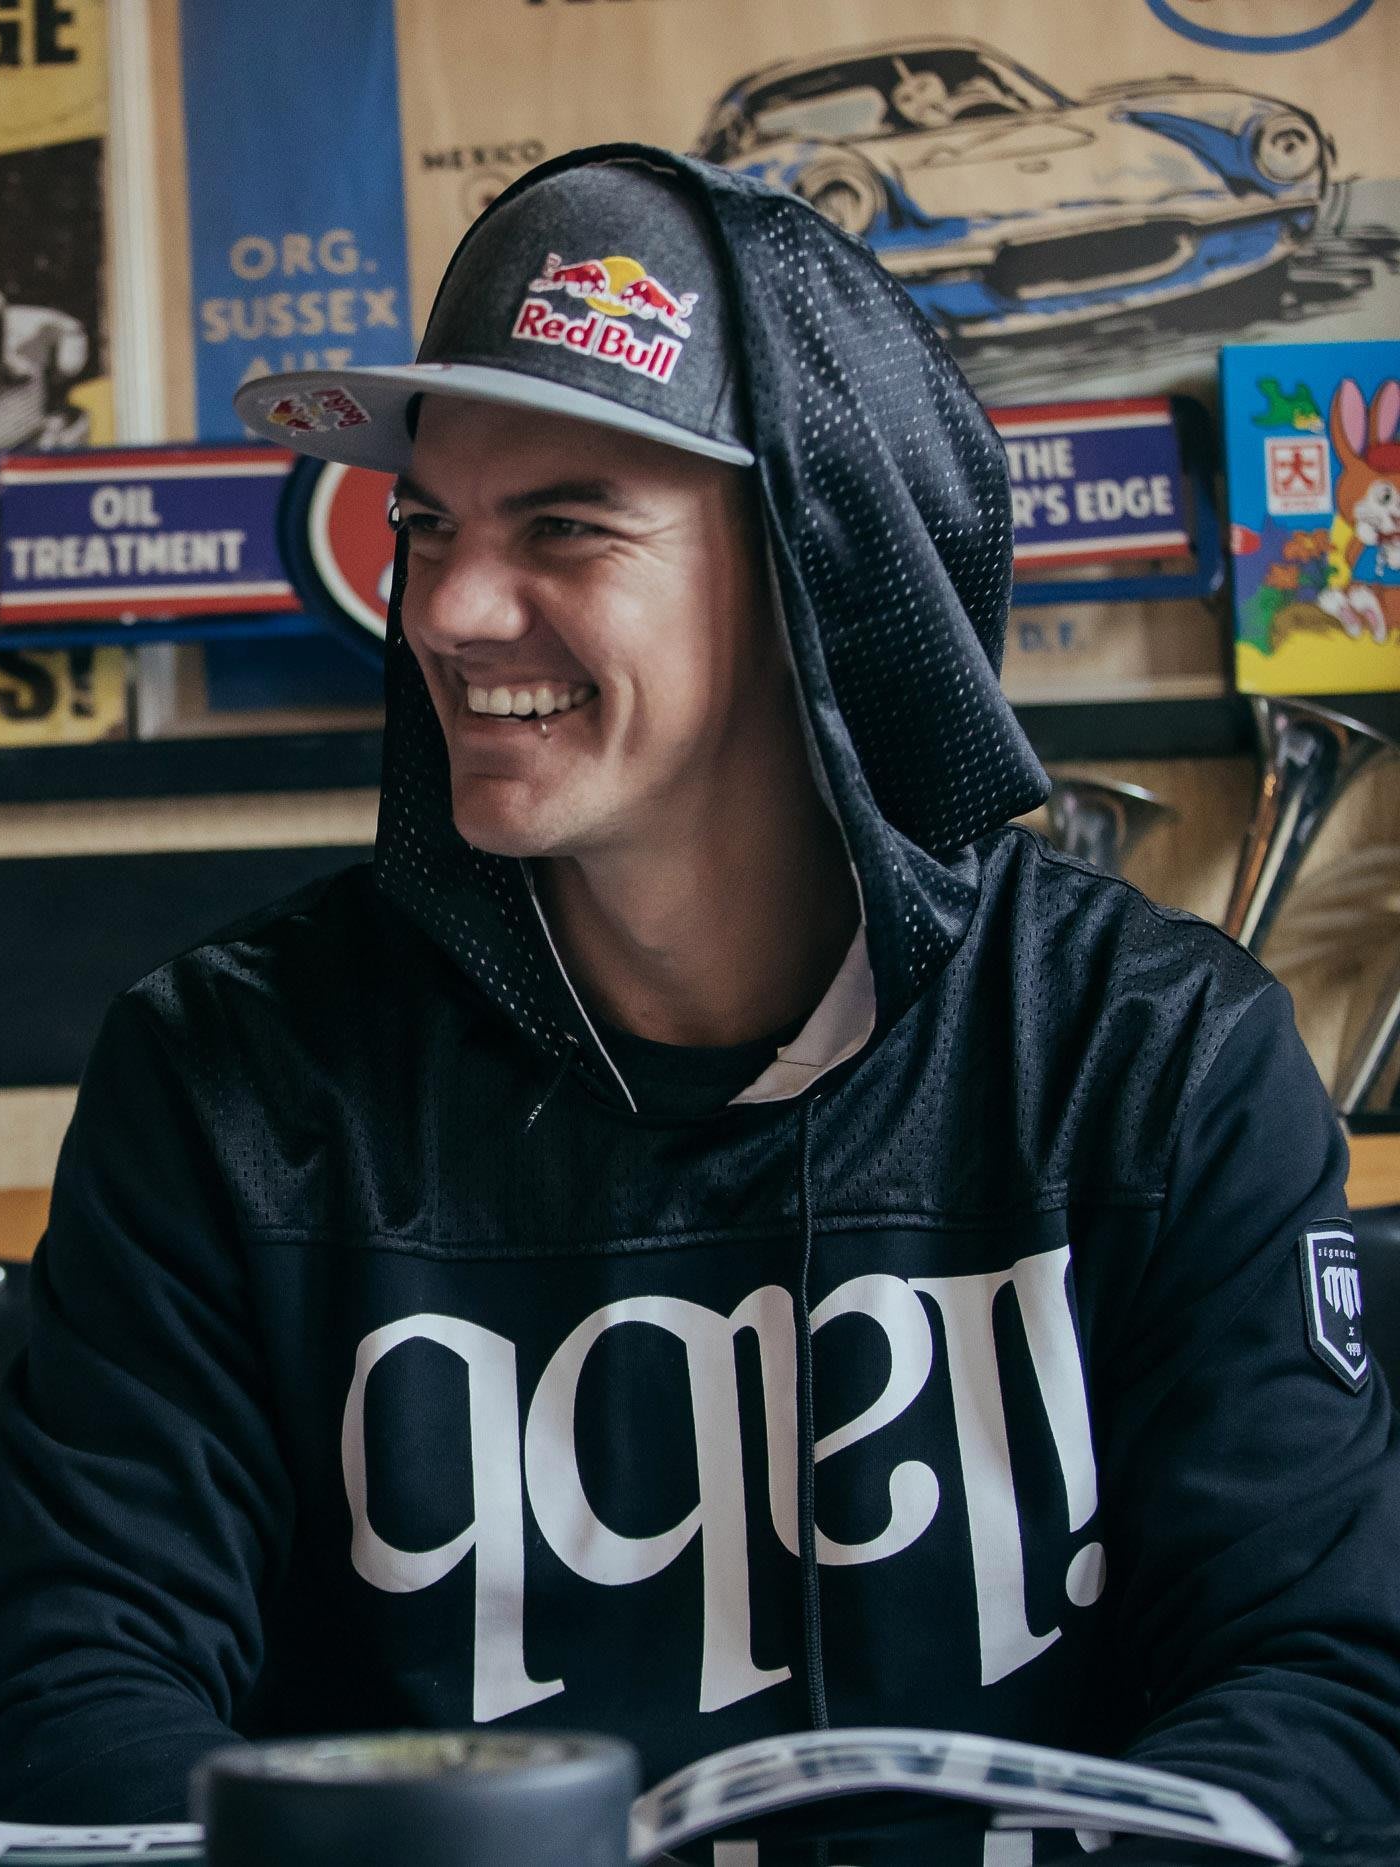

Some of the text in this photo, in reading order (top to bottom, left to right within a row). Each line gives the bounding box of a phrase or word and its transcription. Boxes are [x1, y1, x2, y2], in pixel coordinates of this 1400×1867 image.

[229, 230, 379, 281] ORG.
[202, 288, 399, 343] SUSSEX
[518, 302, 678, 378] Red Bull
[1008, 439, 1075, 482] THE
[89, 485, 163, 530] OIL
[1012, 475, 1175, 529] R'S EDGE
[6, 529, 247, 580] TREATMENT
